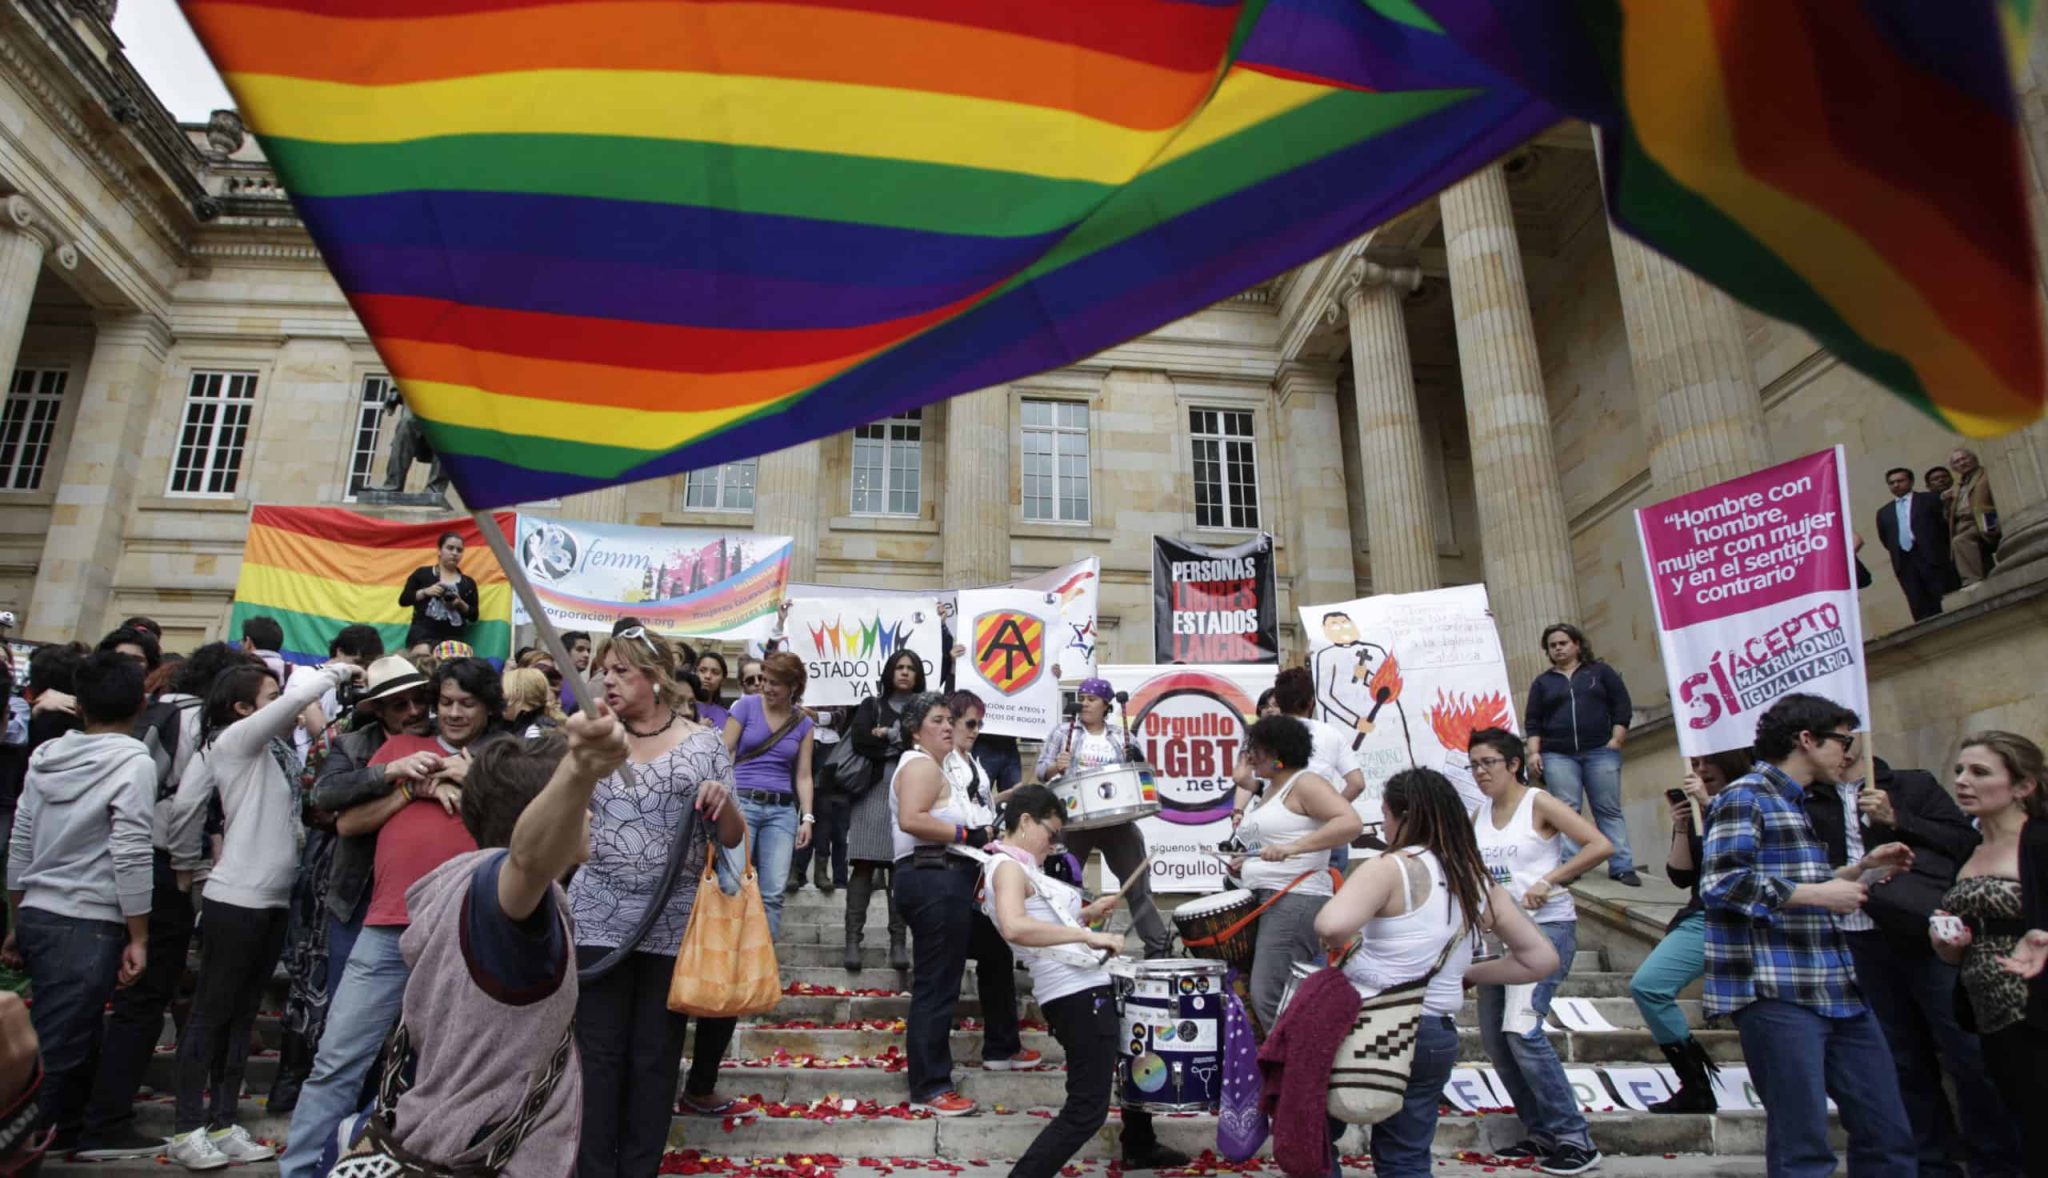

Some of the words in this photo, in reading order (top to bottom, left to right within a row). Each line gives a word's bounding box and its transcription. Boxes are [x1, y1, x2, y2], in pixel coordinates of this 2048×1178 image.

[1767, 475, 1812, 501] con
[1693, 506, 1788, 545] hombre,
[1657, 546, 1718, 577] mujer
[1723, 532, 1765, 559] con
[1770, 511, 1836, 543] mujer
[1172, 556, 1257, 582] PERSONAS
[1671, 575, 1685, 596] y
[1689, 566, 1716, 587] en
[1720, 557, 1740, 579] el
[1744, 534, 1828, 573] sentido
[1172, 579, 1258, 612] LIBRES
[1173, 608, 1258, 635] ESTADOS
[1173, 633, 1260, 662] LAICOS
[1736, 627, 1846, 691] MATRIMONIO
[806, 660, 869, 679] STADO
[1680, 650, 1741, 730] SÍ
[1728, 602, 1841, 677] ACEPTO
[1743, 649, 1851, 710] IGUALITARIO
[1145, 712, 1234, 740] Orgullo
[1147, 738, 1239, 778] LGBT
[1176, 777, 1231, 791] .net
